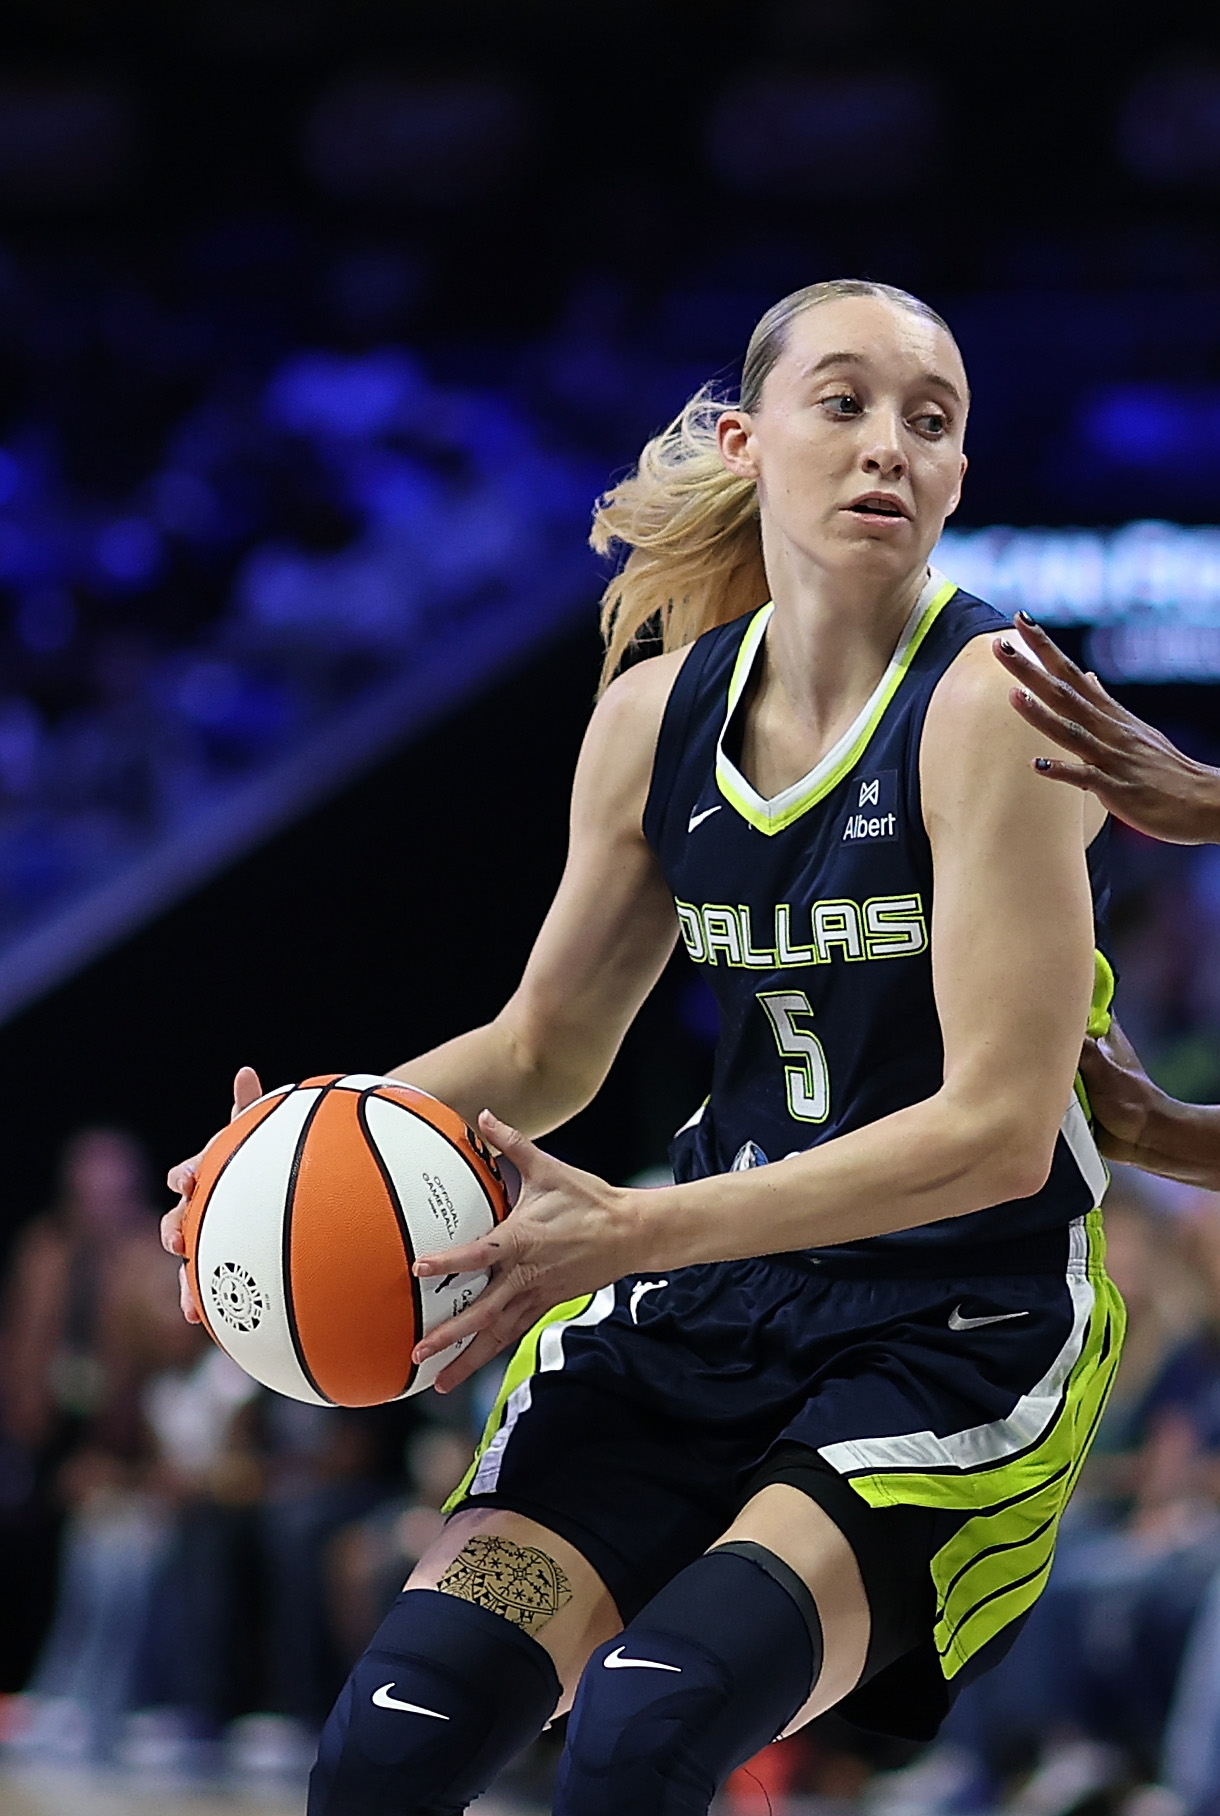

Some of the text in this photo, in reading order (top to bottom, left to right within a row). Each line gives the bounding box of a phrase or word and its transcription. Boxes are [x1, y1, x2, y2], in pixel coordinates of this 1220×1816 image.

[842, 812, 897, 841] Albert
[675, 893, 929, 969] DALLAS
[755, 990, 830, 1124] 5
[422, 1172, 455, 1241] GAME BALL
[433, 1176, 459, 1229] OFFICIAL
